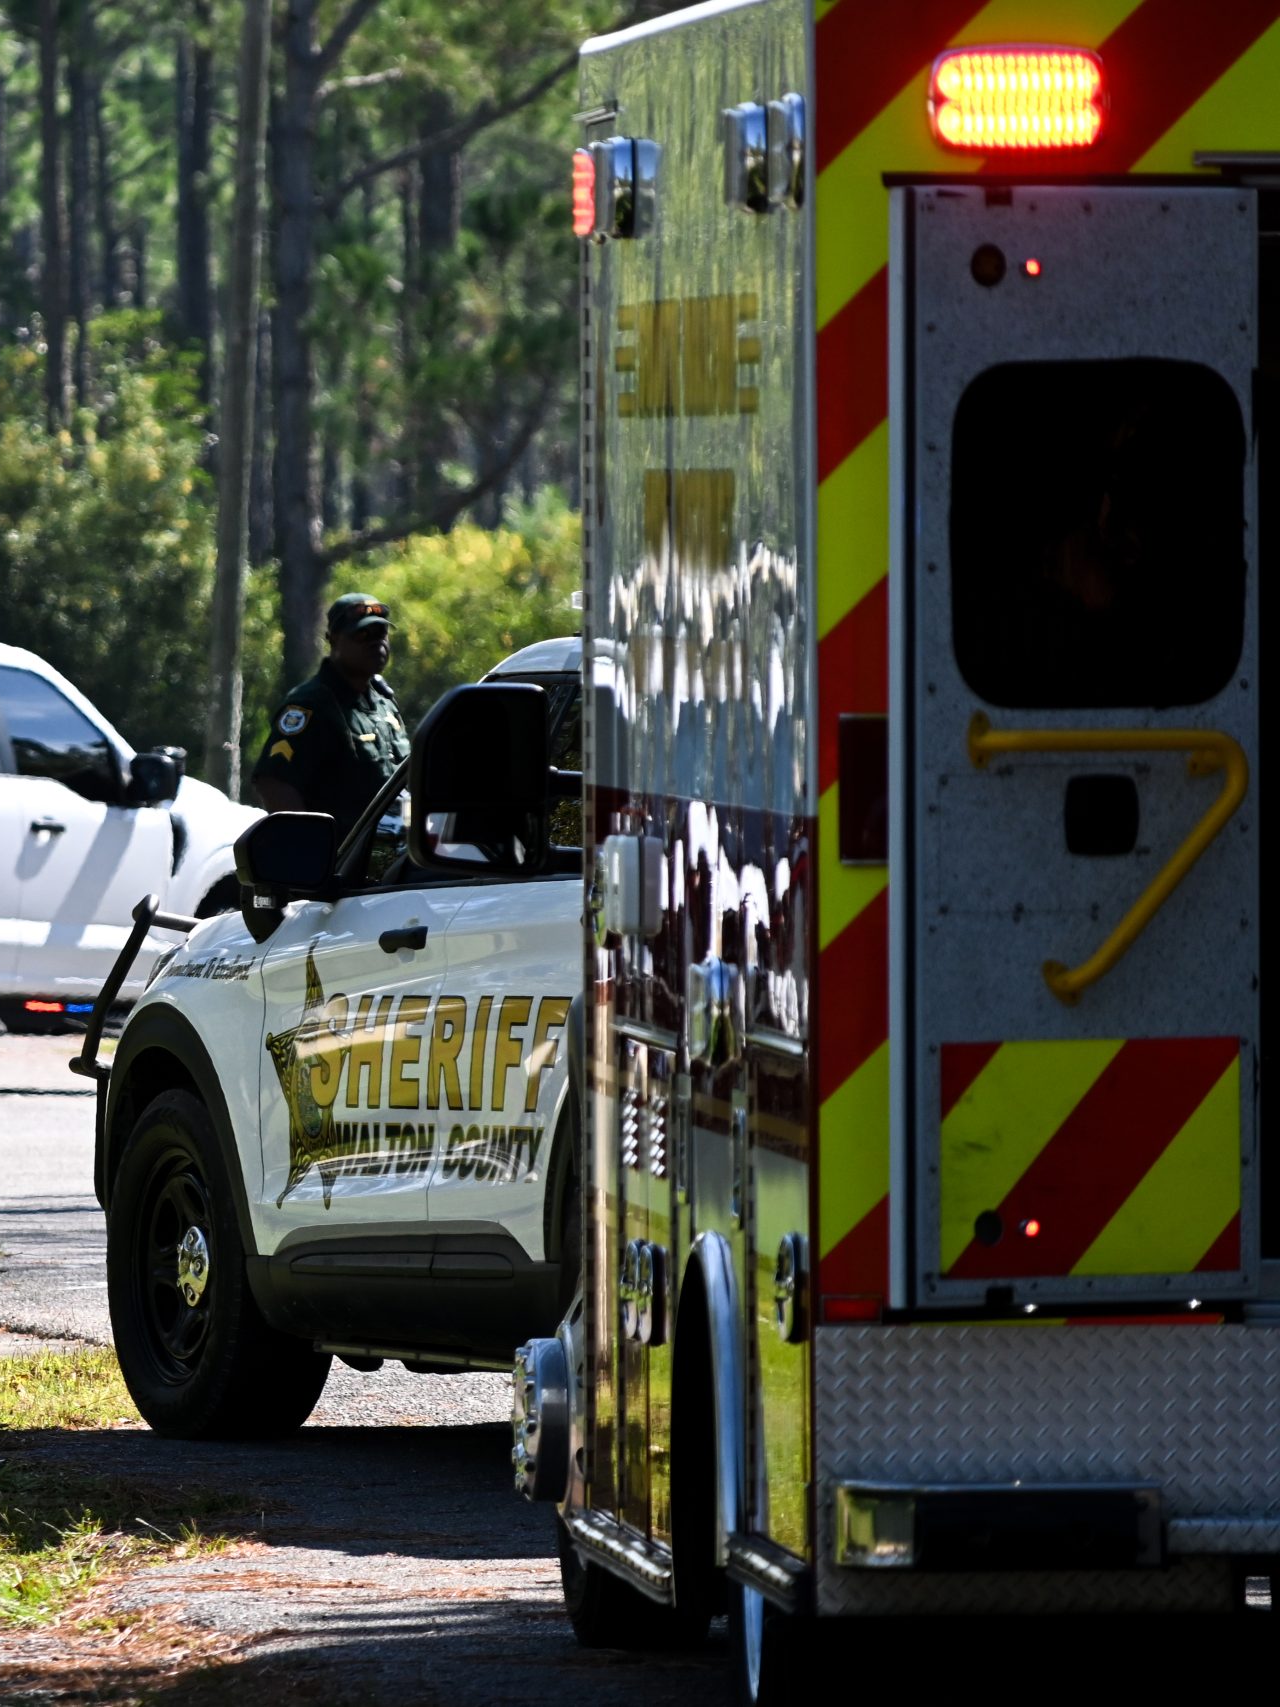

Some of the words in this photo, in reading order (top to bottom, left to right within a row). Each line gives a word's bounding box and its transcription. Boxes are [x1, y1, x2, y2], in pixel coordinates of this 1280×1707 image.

[309, 992, 573, 1113] SHERIFF
[330, 1121, 436, 1178] WALTON
[442, 1123, 544, 1184] COUNTY
